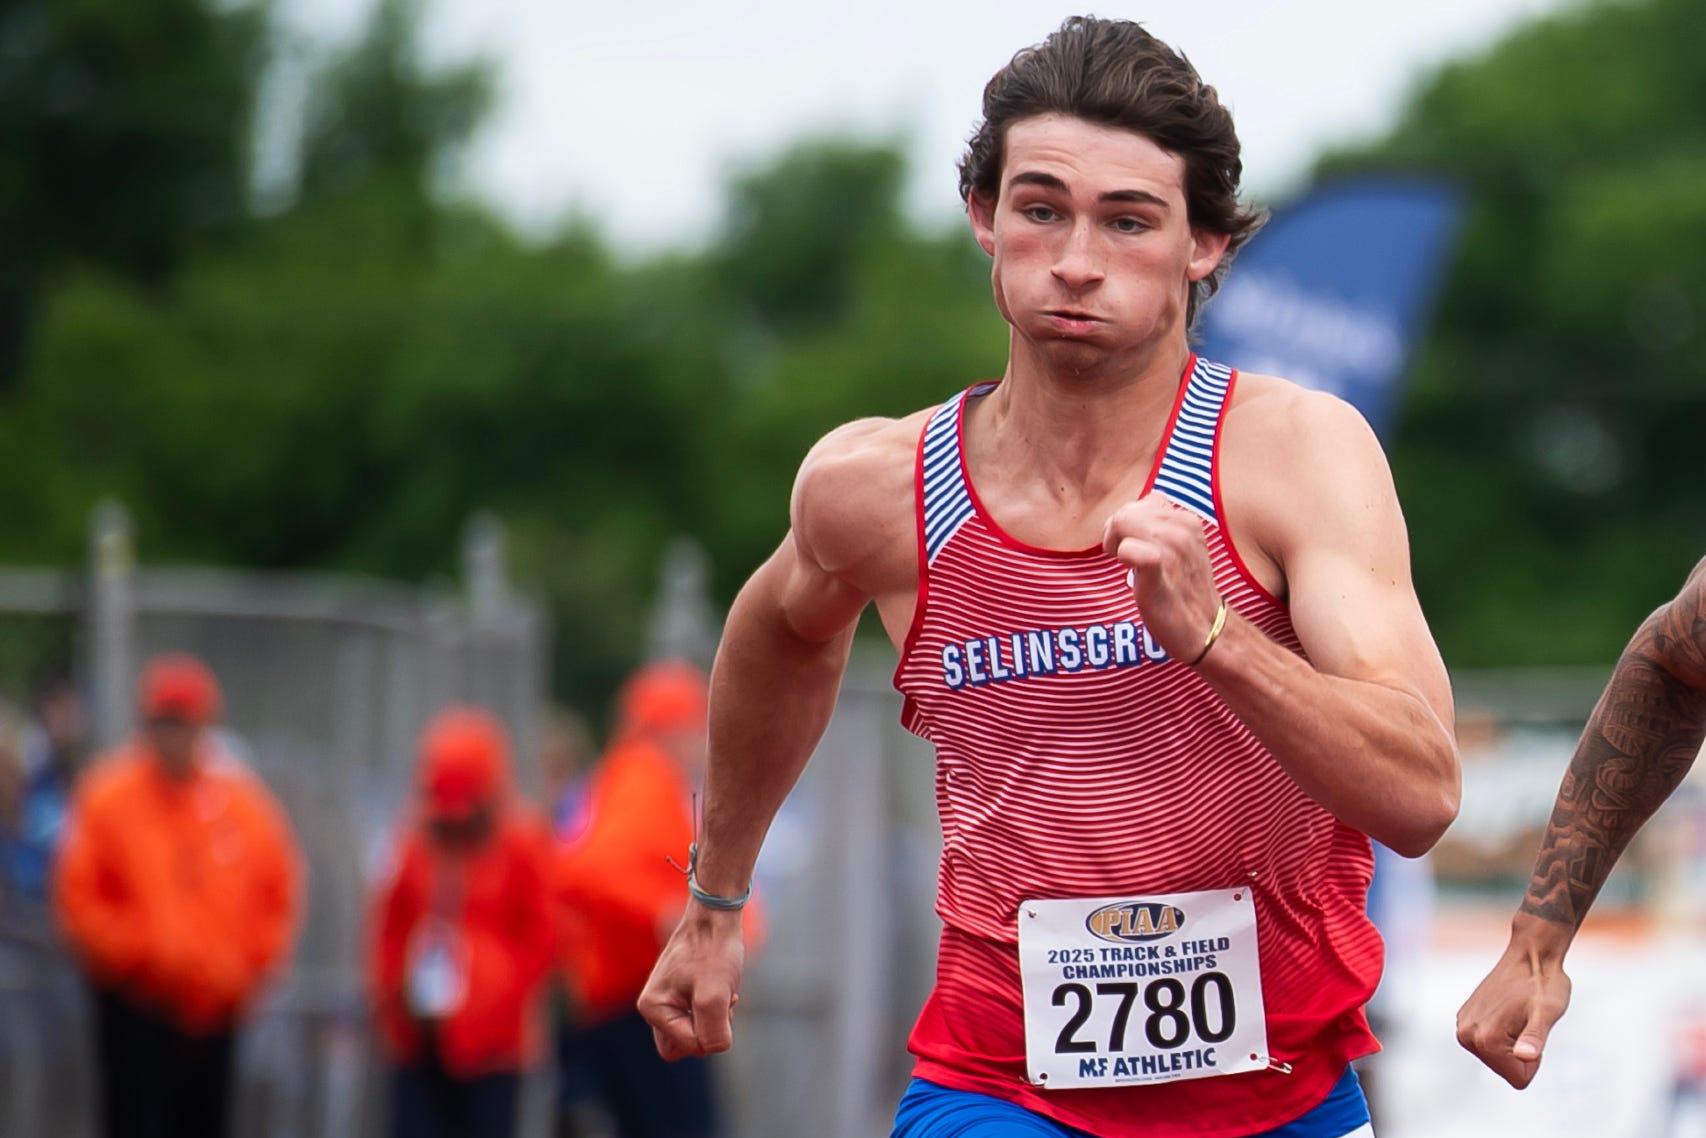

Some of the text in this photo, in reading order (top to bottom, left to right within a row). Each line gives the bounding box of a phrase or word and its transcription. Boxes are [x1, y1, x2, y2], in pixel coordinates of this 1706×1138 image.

[1101, 906, 1179, 936] PIAA
[1048, 937, 1230, 964] 2025 TRACK & FIELD
[1063, 954, 1217, 979] CHAMPIONSHIPS
[1051, 972, 1236, 1054] 2780
[1079, 1047, 1217, 1078] MF ATHLETIC
